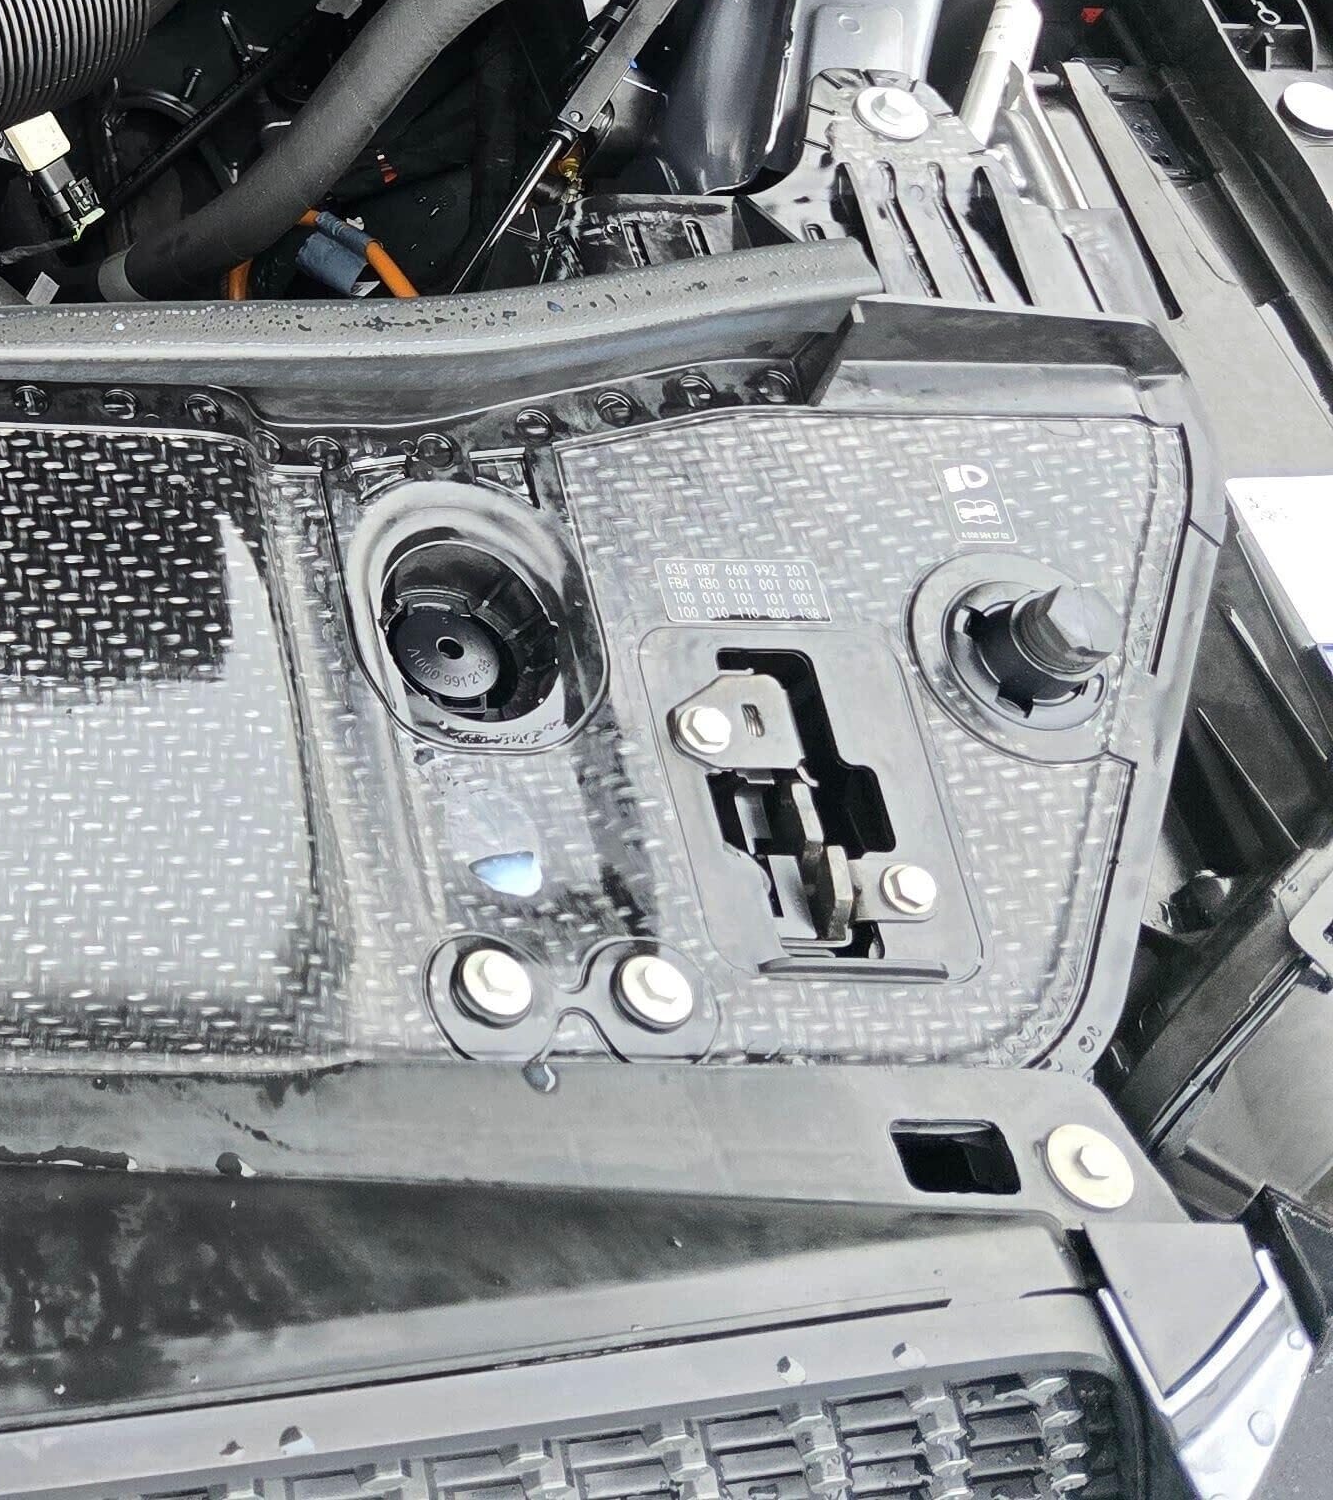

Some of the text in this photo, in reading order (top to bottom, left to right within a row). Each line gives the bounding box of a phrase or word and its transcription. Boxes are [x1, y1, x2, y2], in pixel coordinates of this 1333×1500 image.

[665, 563, 808, 577] 635 087 660 992 201
[728, 578, 751, 590] 011
[759, 579, 781, 591] 001
[788, 579, 813, 591] 001
[673, 592, 816, 605] 100 010 101 101 001
[677, 606, 699, 619] 100
[706, 607, 730, 619] 010
[737, 607, 759, 619] 110
